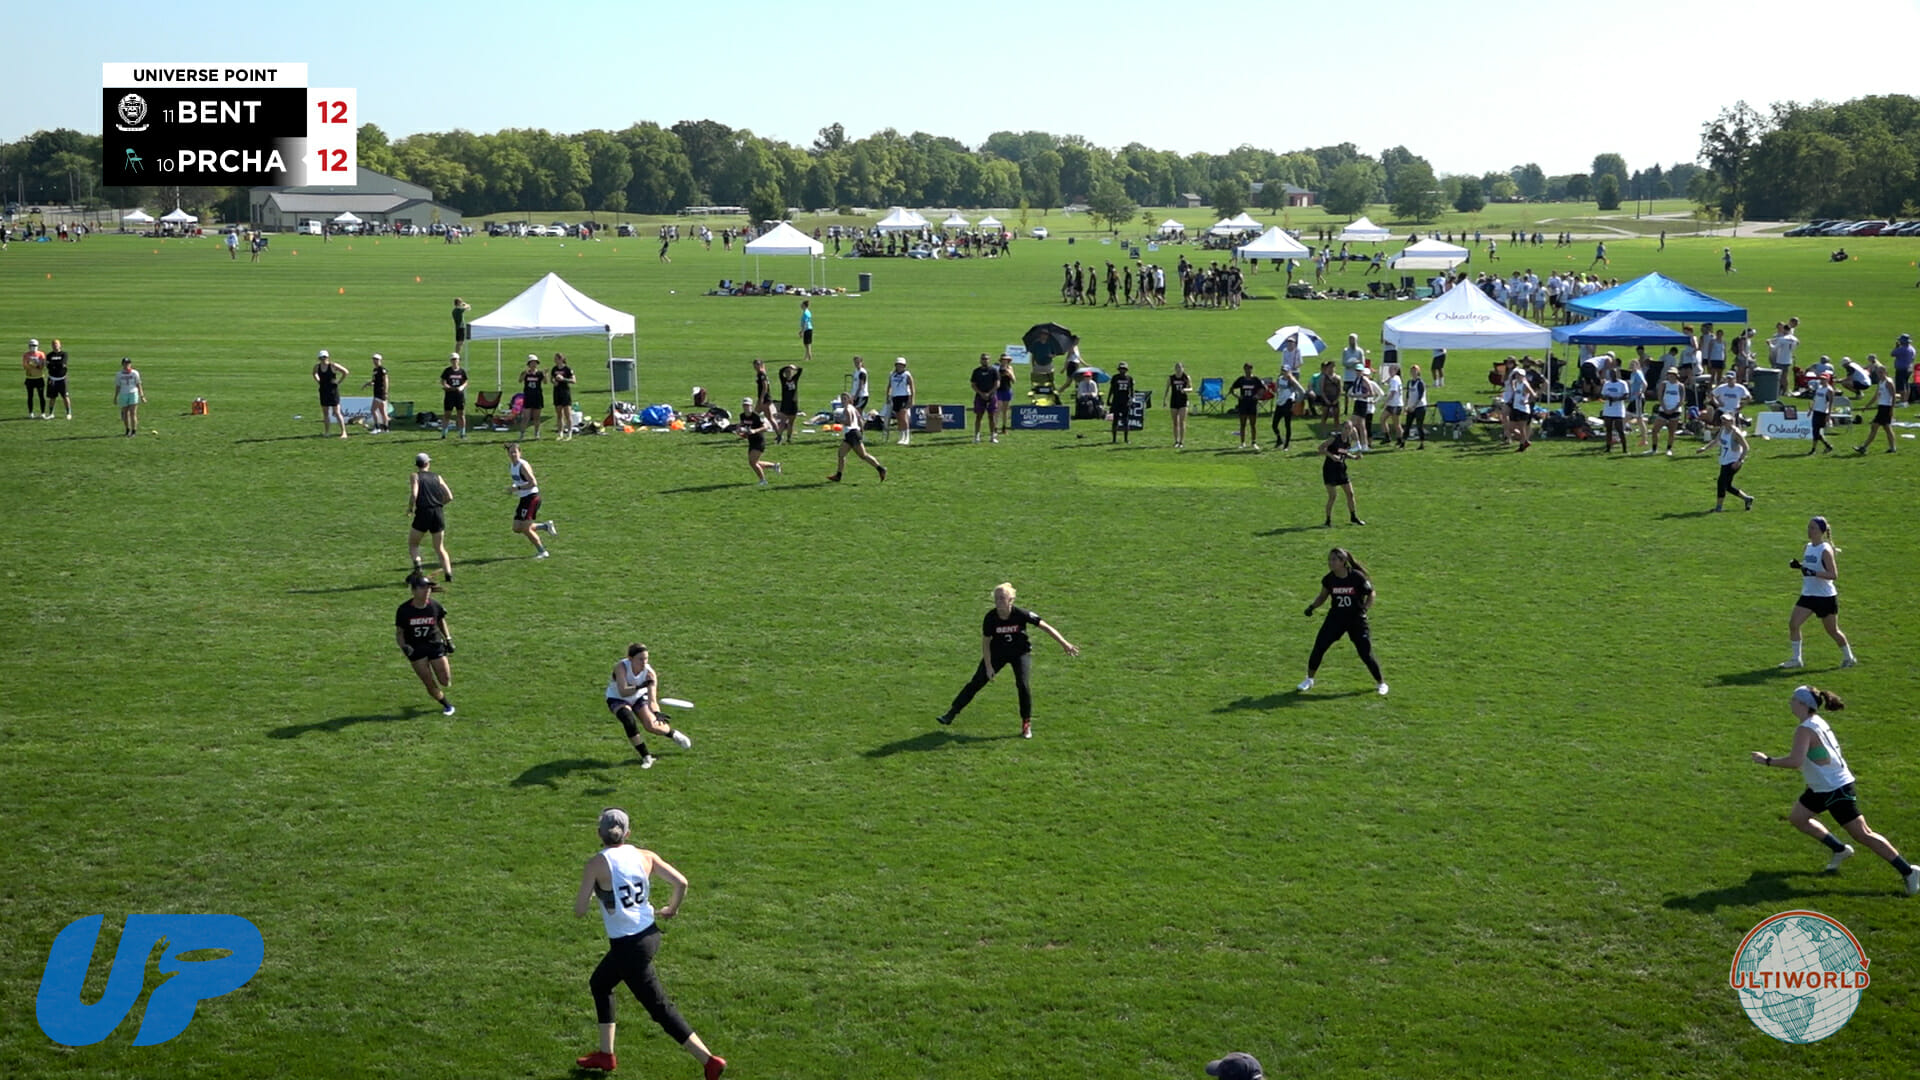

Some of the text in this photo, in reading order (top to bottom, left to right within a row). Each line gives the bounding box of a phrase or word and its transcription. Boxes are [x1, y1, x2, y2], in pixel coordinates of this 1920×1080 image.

[1019, 407, 1039, 415] USA
[1332, 586, 1356, 595] BENT
[1336, 595, 1352, 608] 20
[409, 616, 435, 626] BENT
[414, 626, 430, 638] 57
[995, 624, 1018, 634] BENT
[1004, 634, 1013, 642] 3
[618, 881, 646, 909] 22
